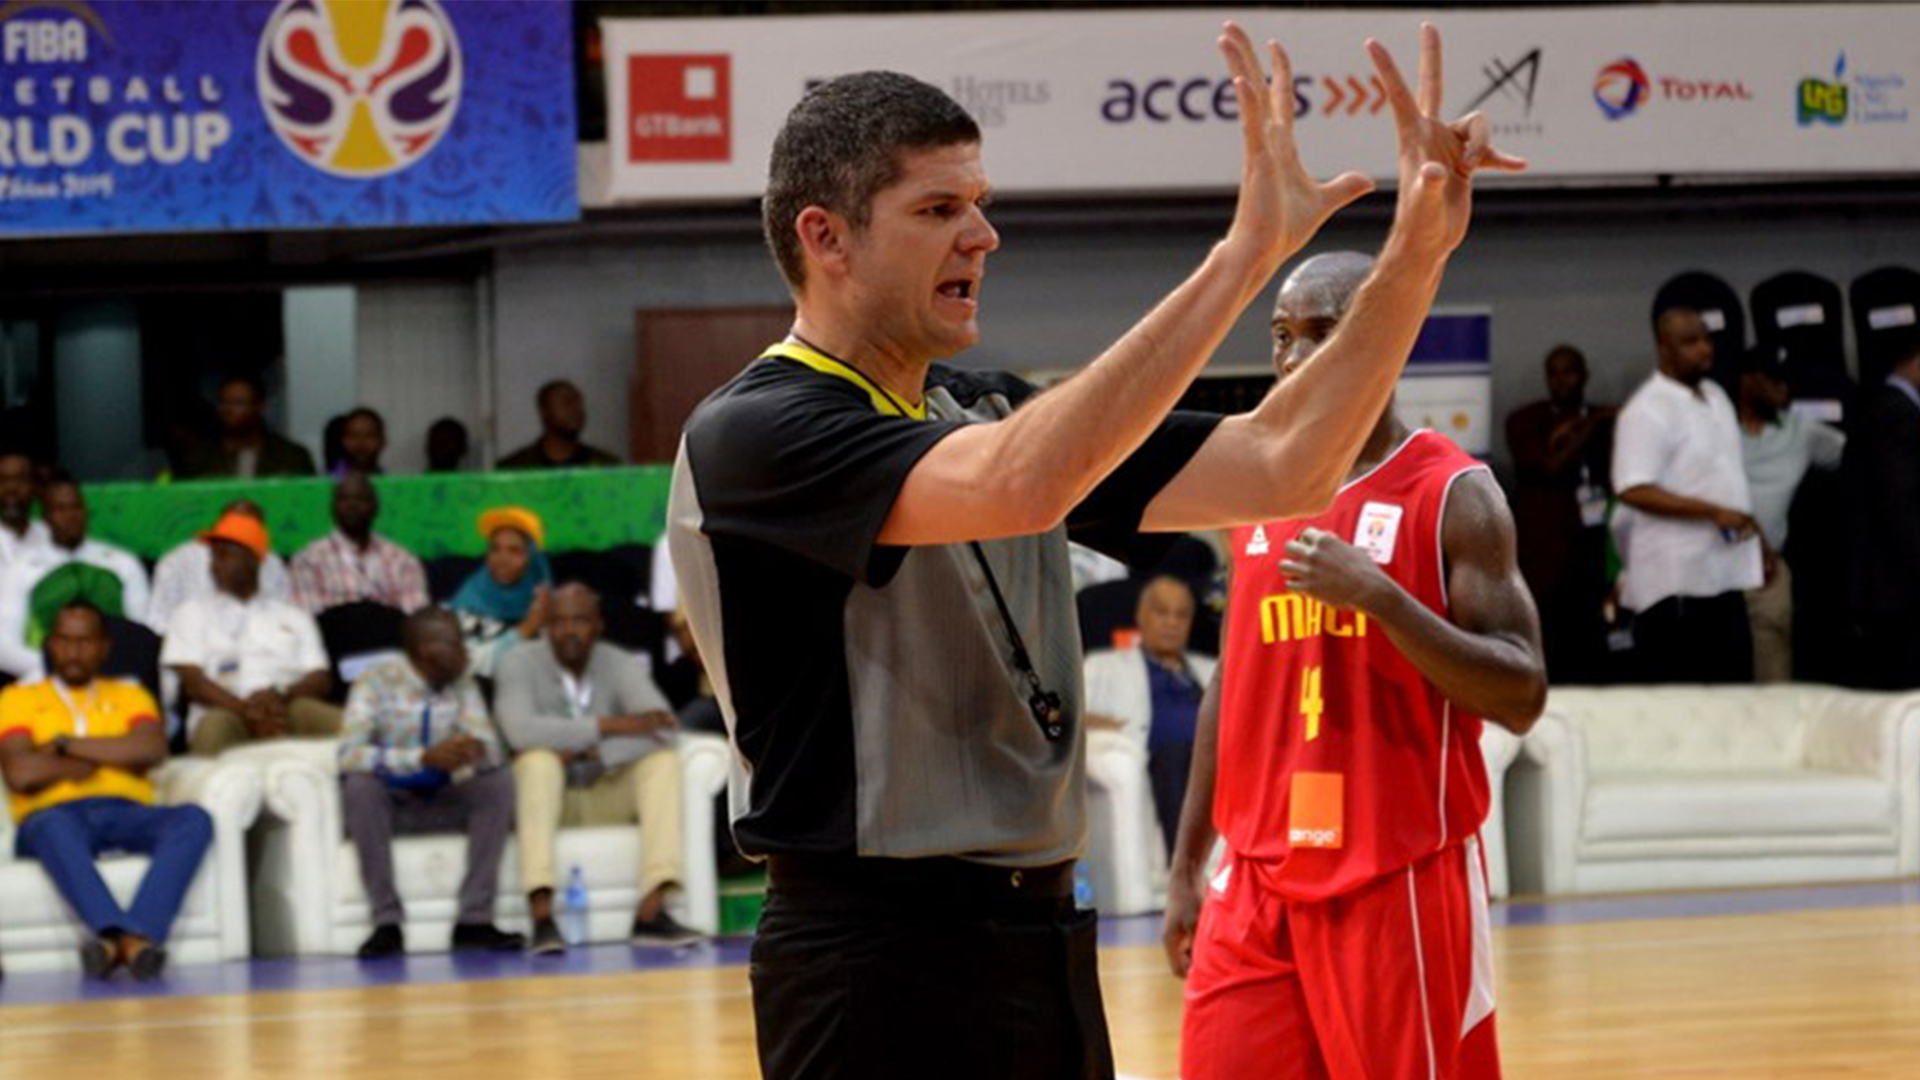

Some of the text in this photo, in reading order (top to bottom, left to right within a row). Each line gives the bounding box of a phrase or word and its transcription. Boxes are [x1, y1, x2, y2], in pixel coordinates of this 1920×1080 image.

[4, 19, 87, 63] FIBA
[1101, 76, 1312, 122] acces
[106, 111, 231, 166] CUP
[634, 112, 720, 138] GTBank
[1300, 665, 1323, 742] 4
